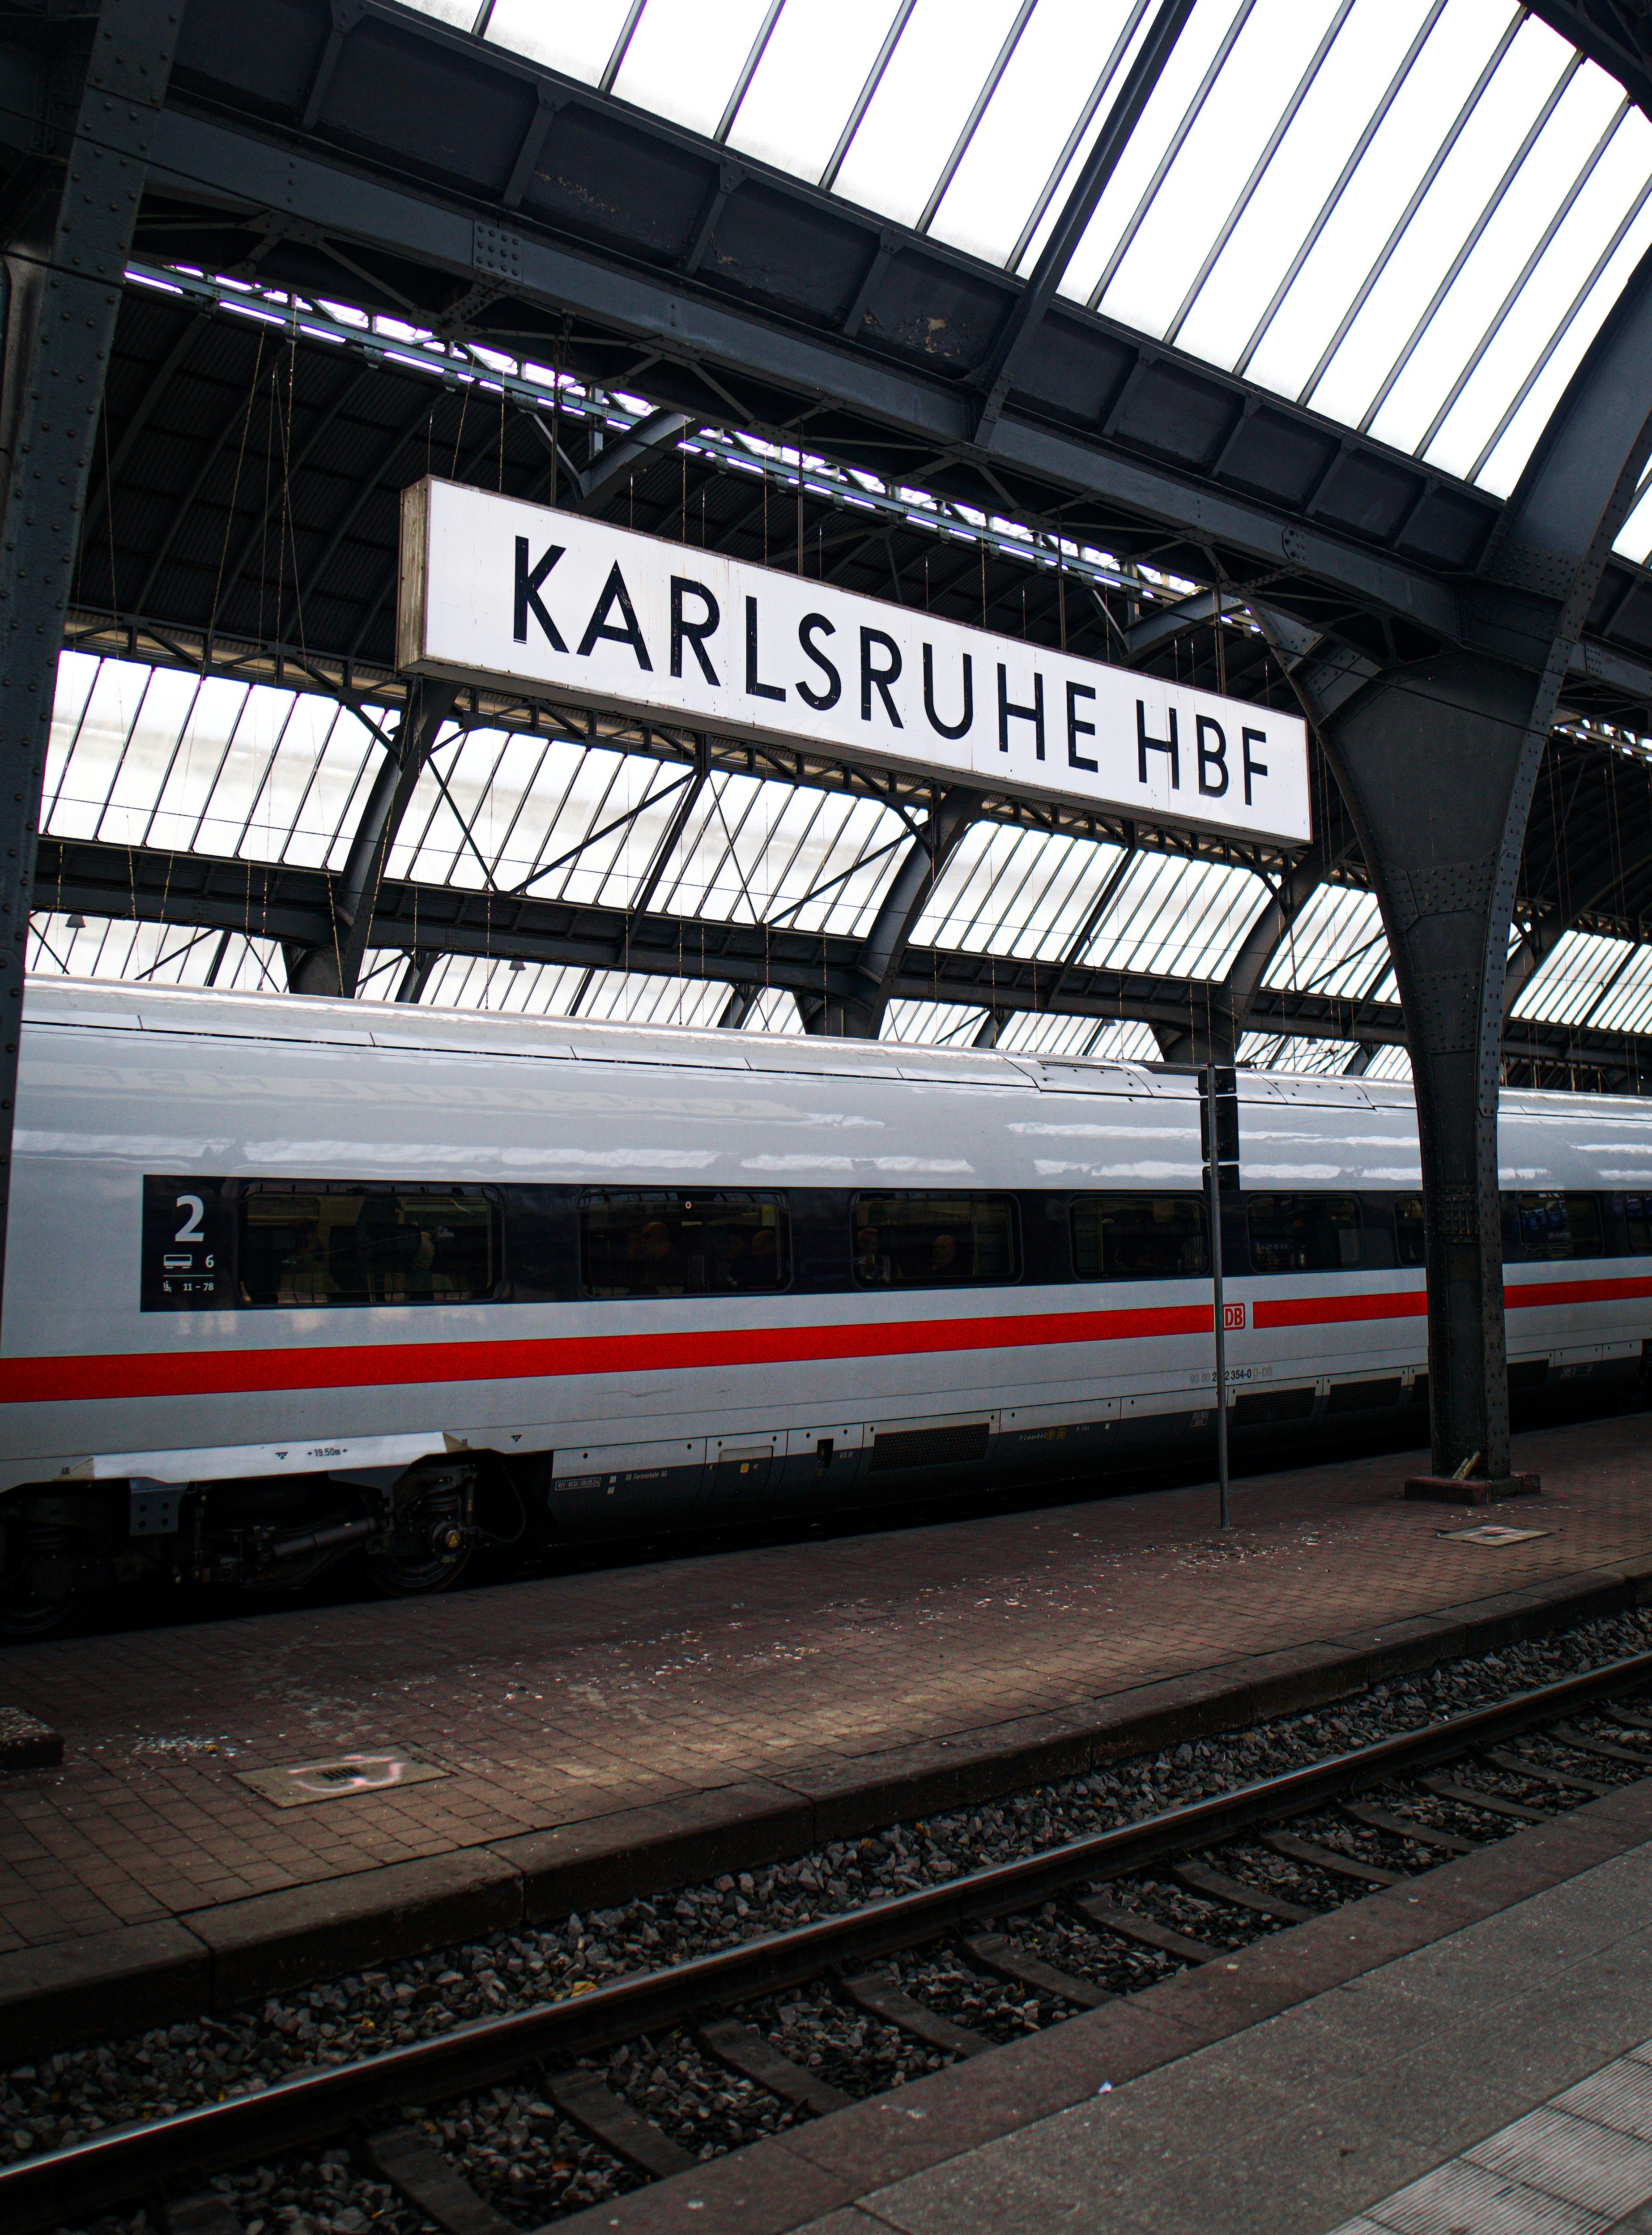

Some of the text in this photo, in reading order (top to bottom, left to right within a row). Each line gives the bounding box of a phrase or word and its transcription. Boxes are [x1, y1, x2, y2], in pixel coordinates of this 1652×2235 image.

[513, 535, 1268, 806] KARLSRUHE HBF
[175, 1194, 204, 1242] 2
[205, 1254, 214, 1268] 6
[183, 1283, 193, 1291] 11
[203, 1283, 214, 1291] 78
[1225, 1308, 1243, 1326] DB
[314, 1447, 341, 1457] 19.50m
